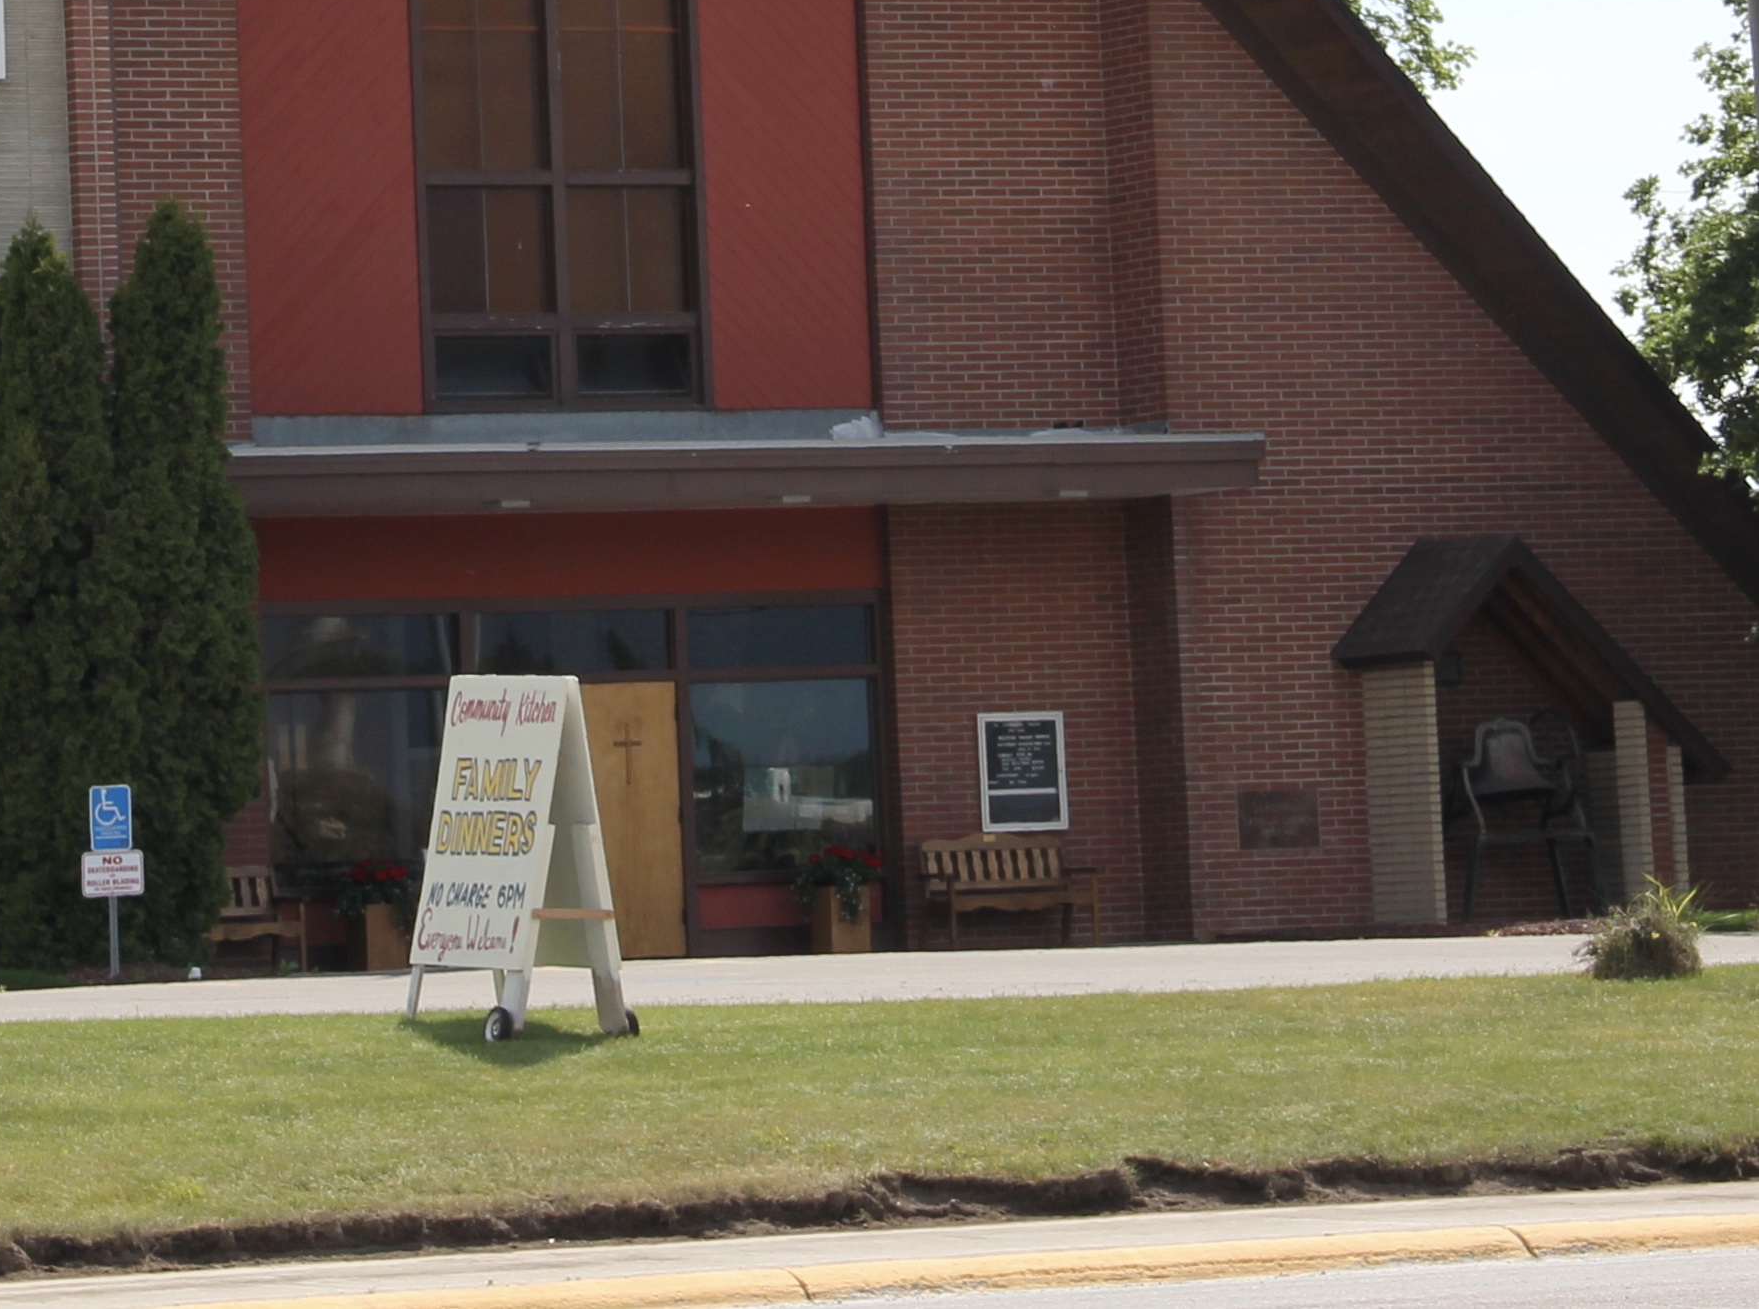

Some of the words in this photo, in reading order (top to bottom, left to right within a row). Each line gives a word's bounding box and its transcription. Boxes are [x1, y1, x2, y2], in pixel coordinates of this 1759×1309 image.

[450, 688, 512, 737] Community
[516, 689, 557, 726] Kitchen
[451, 757, 543, 802] FAMILY
[435, 810, 538, 856] DINNERS
[102, 856, 122, 864] NO
[426, 882, 444, 908] NO
[446, 882, 492, 908] CHARGE
[497, 882, 527, 909] 6PM
